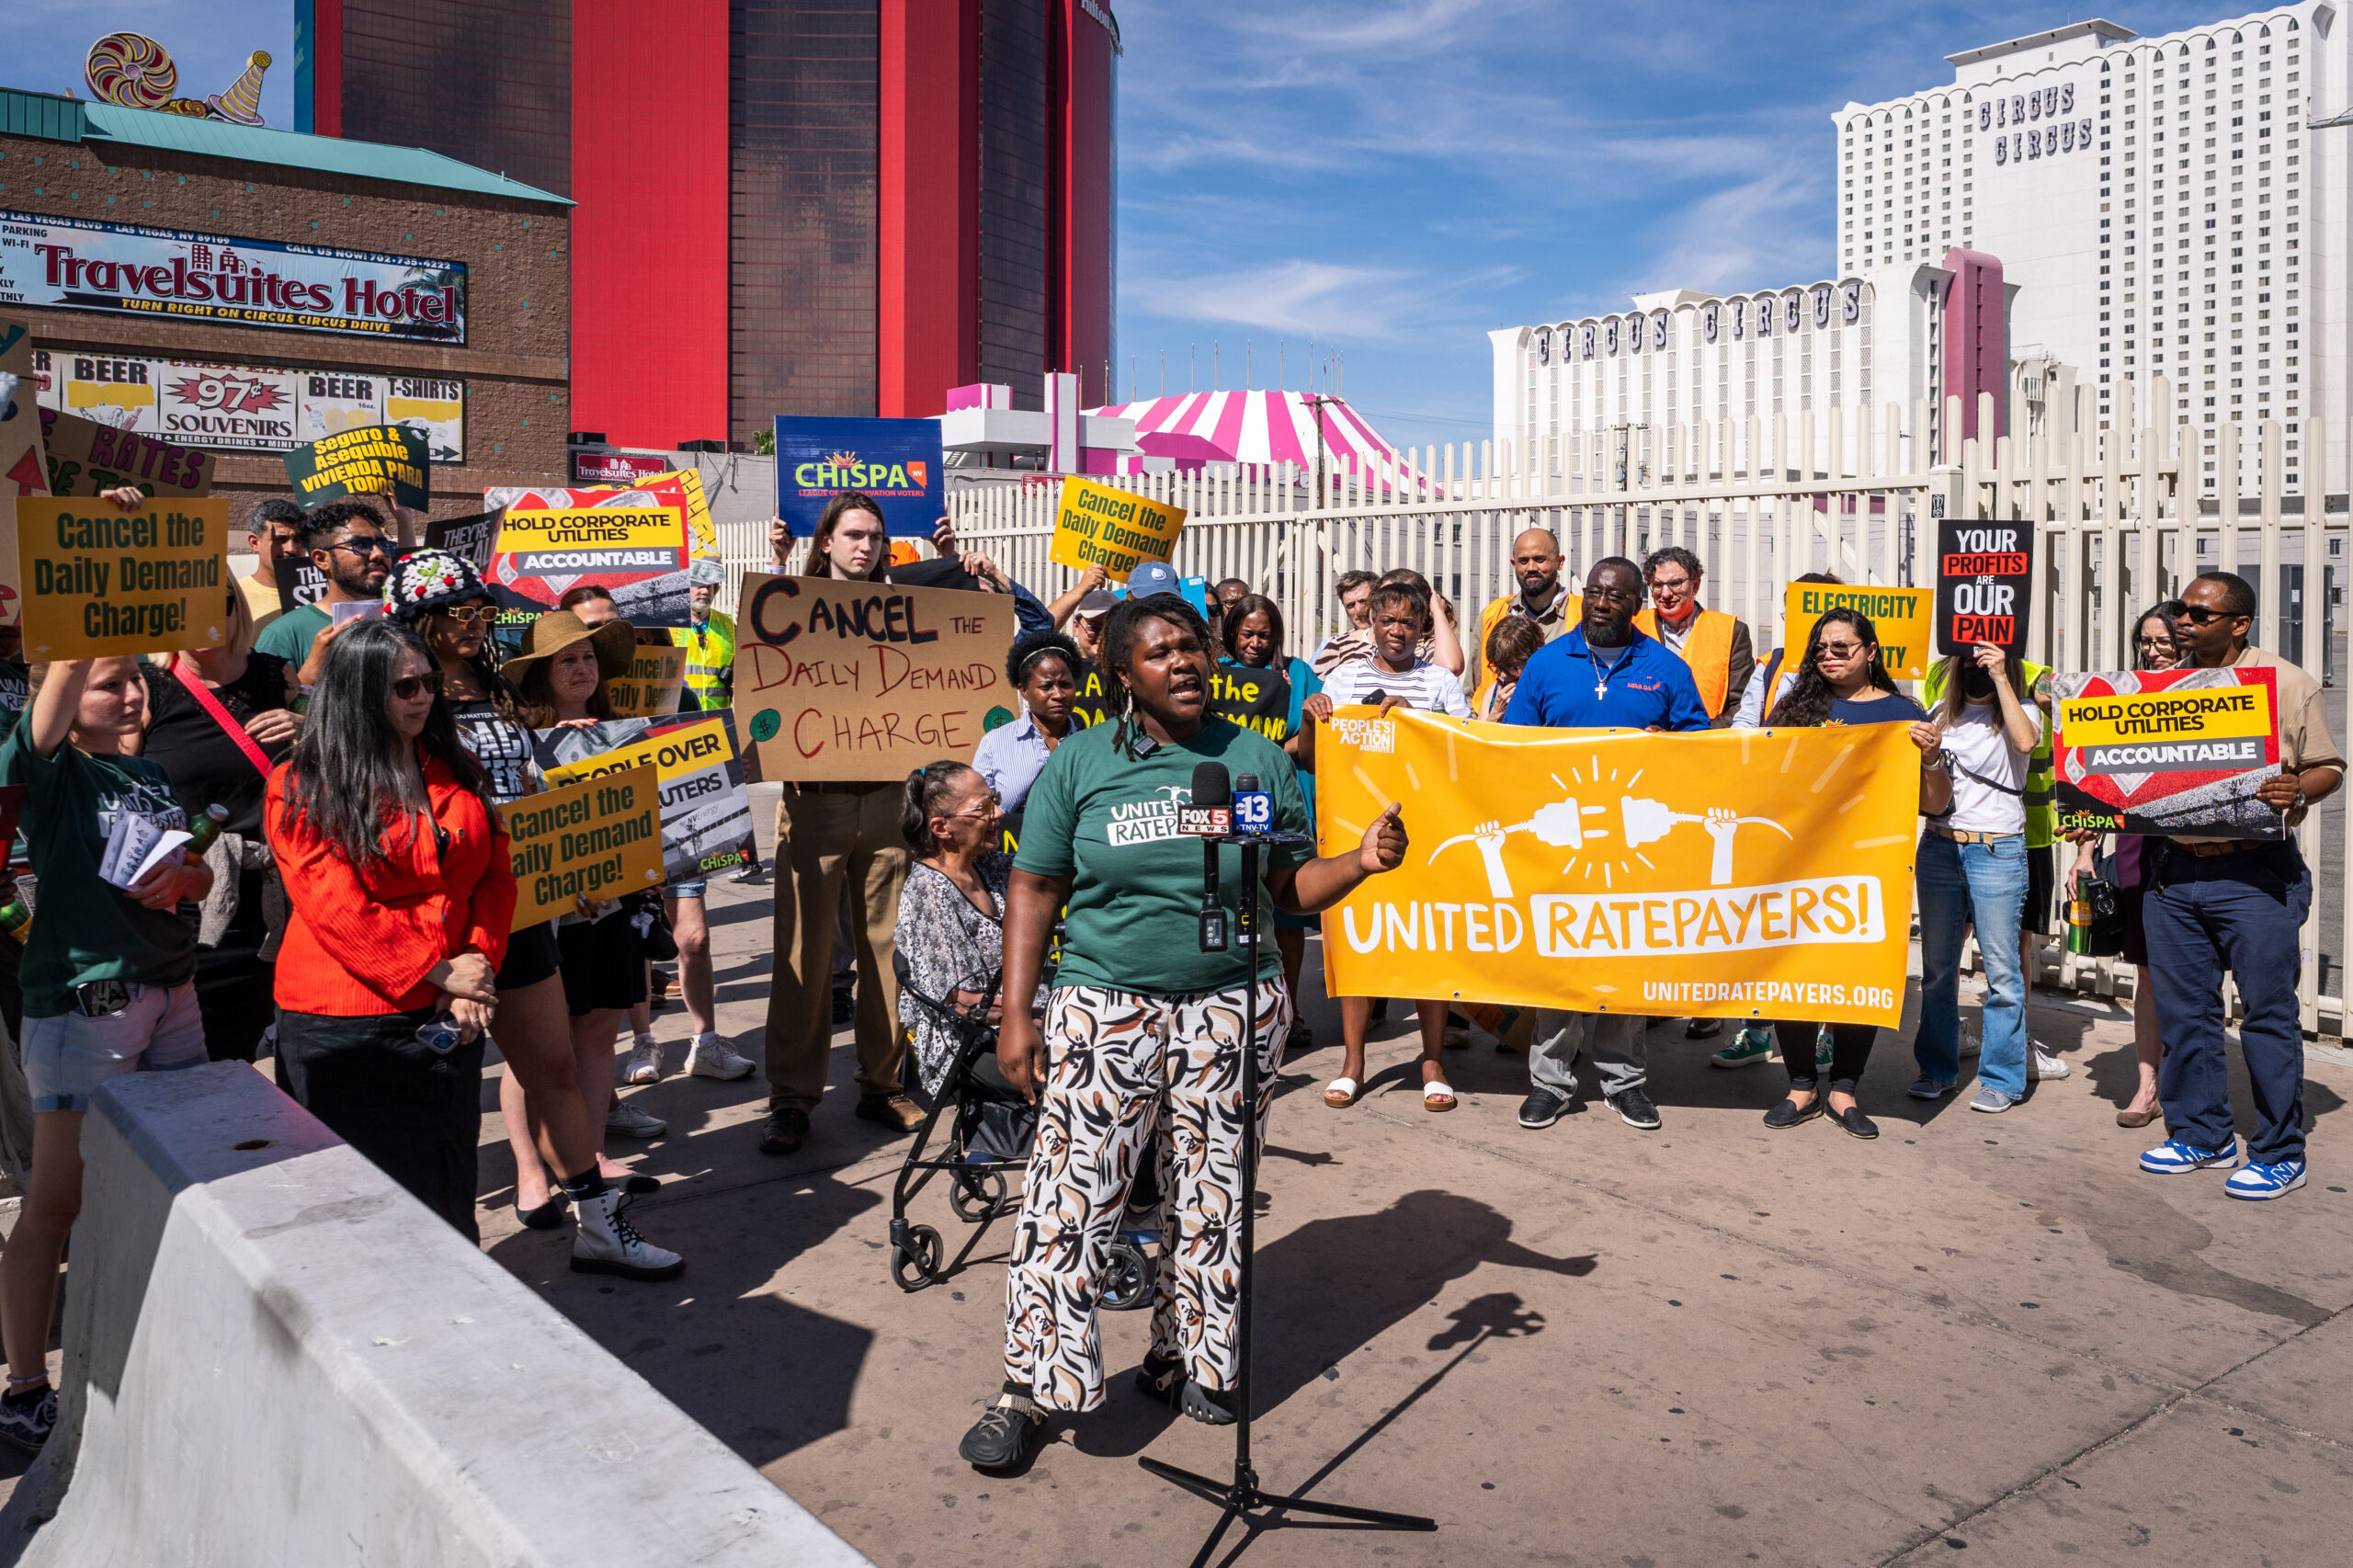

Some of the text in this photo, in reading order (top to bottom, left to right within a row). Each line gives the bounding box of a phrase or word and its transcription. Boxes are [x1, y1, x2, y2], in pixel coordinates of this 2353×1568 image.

[1979, 83, 2074, 130] CIRCUS
[1995, 119, 2092, 165] CIRCUS
[2, 224, 48, 238] PARKING
[10, 212, 31, 222] LAS
[35, 214, 71, 227] VEGAS
[74, 219, 103, 230] BLVD
[115, 223, 134, 234] LAS
[138, 227, 176, 240] VEGAS,
[179, 232, 194, 242] NV
[197, 233, 231, 244] 89109
[2, 238, 29, 248] WI-FI
[286, 243, 314, 255] CALL
[317, 246, 333, 256] US
[335, 249, 368, 261] NOW!
[341, 277, 456, 323] Hotel
[122, 298, 391, 333] TURN RIGHT ON CIRCUS CIRCUS DRIVE
[1538, 284, 1860, 365] CIRCUS CIRCUS
[74, 358, 148, 384] BEER
[309, 376, 373, 401] BEER
[387, 378, 460, 401] T-SHIRTS
[165, 414, 293, 438] SOUVENIRS
[175, 435, 214, 445] ENERGY
[217, 437, 256, 447] DRINKS
[267, 439, 292, 449] MINI
[313, 426, 402, 456] Seguro &
[88, 424, 206, 489] RATES
[314, 441, 410, 472] Asequible
[301, 460, 424, 494] VIVIENDA PARA
[342, 476, 396, 497] TODOS
[503, 514, 672, 532] HOLD CORPORATE
[1078, 489, 1166, 531] Cancel the
[57, 512, 205, 550] Cancel the
[444, 520, 491, 548] THEY'RE
[548, 528, 630, 543] UTILITIES
[1062, 509, 1171, 558] Daily Demand
[1955, 529, 2018, 553] YOUR
[524, 551, 673, 570] ACCOUNTABLE
[1949, 555, 2023, 574] PROFITS
[34, 553, 220, 598] Daily Demand
[1975, 575, 1995, 585] ARE
[750, 576, 986, 645] CANCEL THE
[1954, 584, 2015, 616] OUR
[84, 597, 188, 639] Charge!
[1958, 617, 2010, 642] PAIN
[868, 644, 997, 699] DEMAND
[1209, 674, 1260, 703] the
[2068, 694, 2256, 722] HOLD CORPORATE
[794, 708, 972, 759] CHARGE
[1331, 718, 1392, 733] PEOPLE'S
[1339, 731, 1391, 746] ACTION
[2115, 714, 2205, 735] UTILITIES
[657, 733, 722, 767] OVER
[1359, 744, 1390, 754] INSTITUTE
[2092, 742, 2257, 767] ACCOUNTABLE
[659, 772, 723, 809] UTERS
[510, 784, 634, 843] Cancel the
[1181, 810, 1229, 824] FOX 5
[1241, 795, 1270, 823] 13
[1116, 817, 1178, 844] RATEP
[1236, 824, 1269, 832] KTNV-TV
[512, 810, 653, 879] aily Demand
[534, 854, 623, 905] Charge!
[1343, 882, 1869, 954] UNITED RATEPAYERS!
[1643, 981, 1893, 1009] UNITEDRATEPAYERS.ORG
